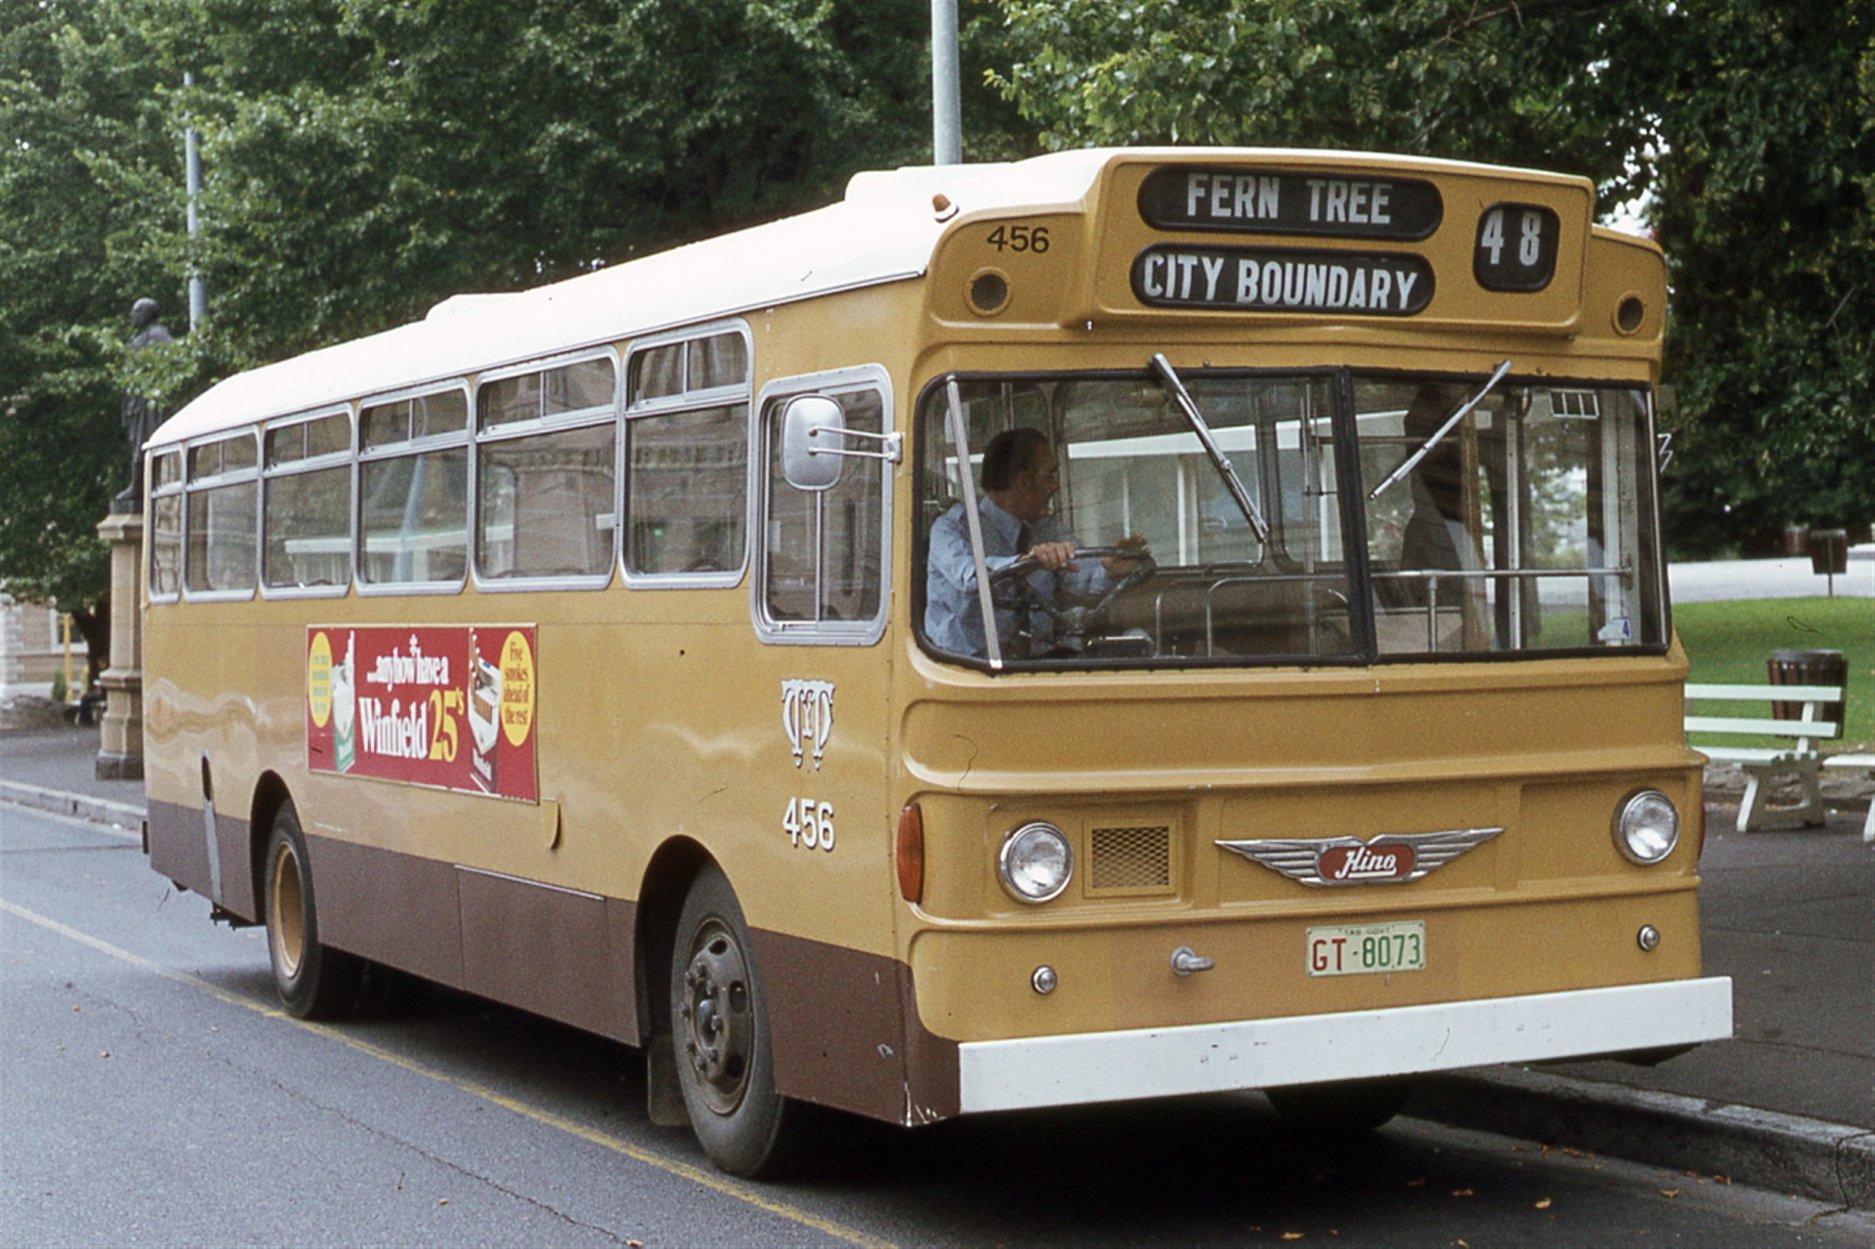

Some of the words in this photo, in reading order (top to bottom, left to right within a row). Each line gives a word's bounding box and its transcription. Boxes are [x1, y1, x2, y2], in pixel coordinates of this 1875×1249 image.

[1186, 173, 1280, 219] FERN
[1306, 179, 1393, 224] TREE
[987, 225, 1050, 253] 456
[1143, 252, 1225, 301] CITY
[1236, 258, 1418, 310] BOUNDARY
[359, 697, 428, 759] Winfield
[783, 797, 835, 851] 456
[1335, 845, 1397, 879] Hino
